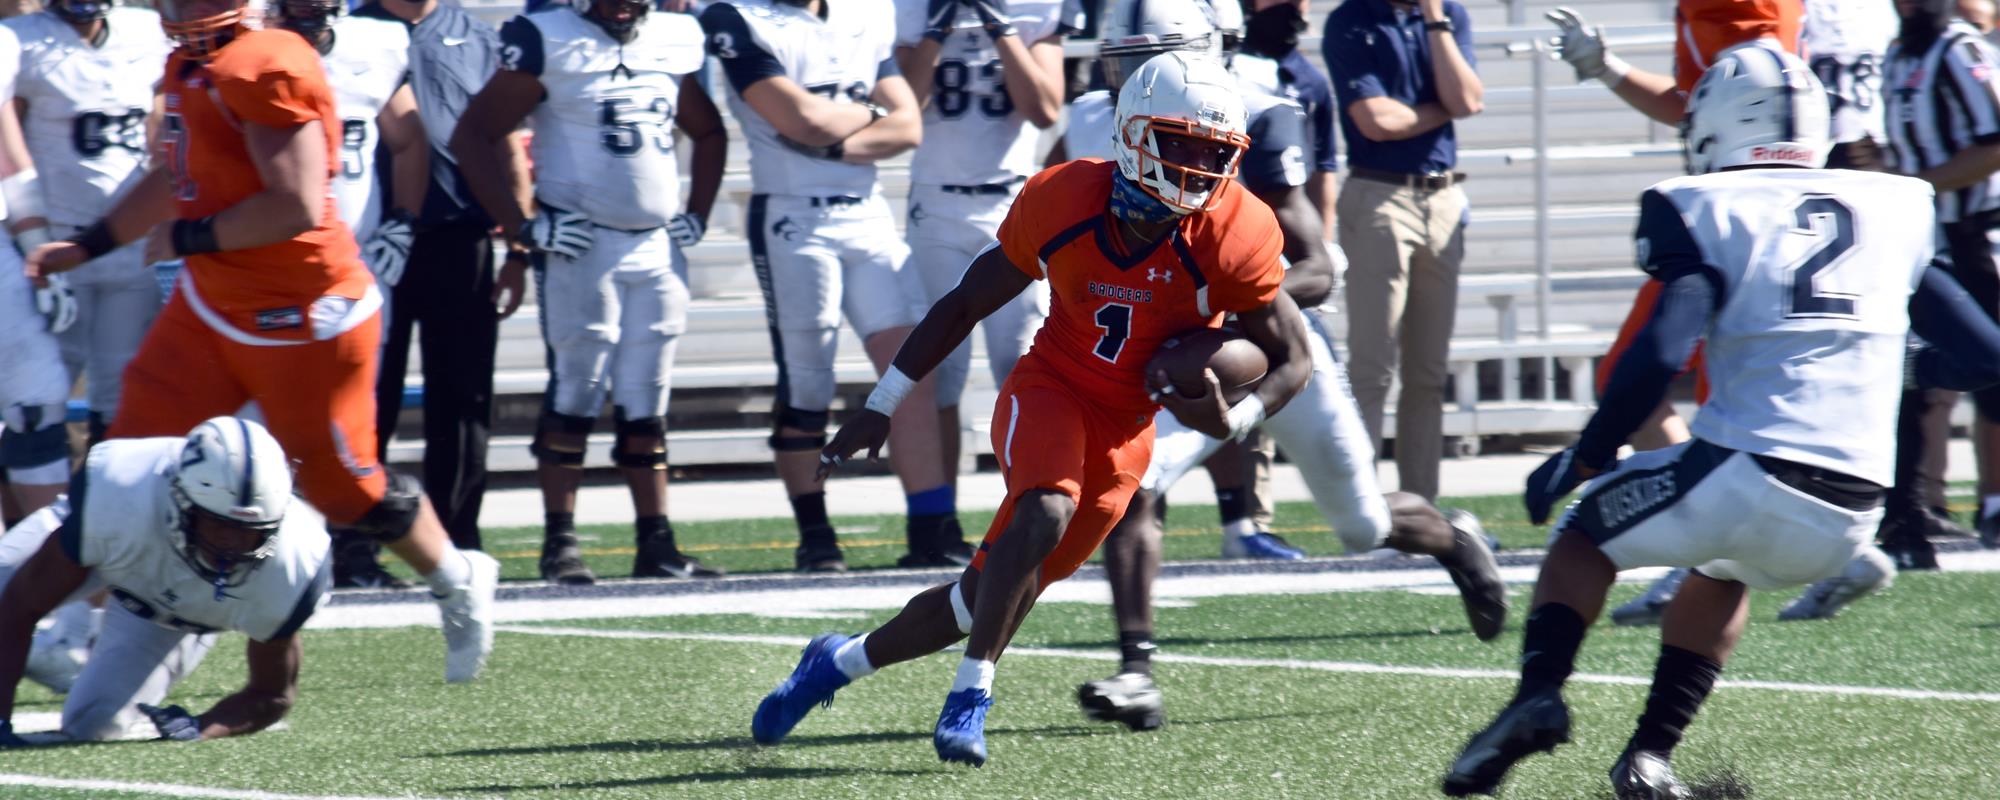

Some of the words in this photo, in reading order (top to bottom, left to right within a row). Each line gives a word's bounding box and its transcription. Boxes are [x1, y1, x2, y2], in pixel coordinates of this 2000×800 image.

[713, 31, 738, 59] 3
[932, 58, 1014, 119] 83
[599, 96, 674, 157] 53
[1783, 192, 1863, 321] 2
[1088, 280, 1153, 303] BADGERS
[1091, 301, 1134, 365] 1
